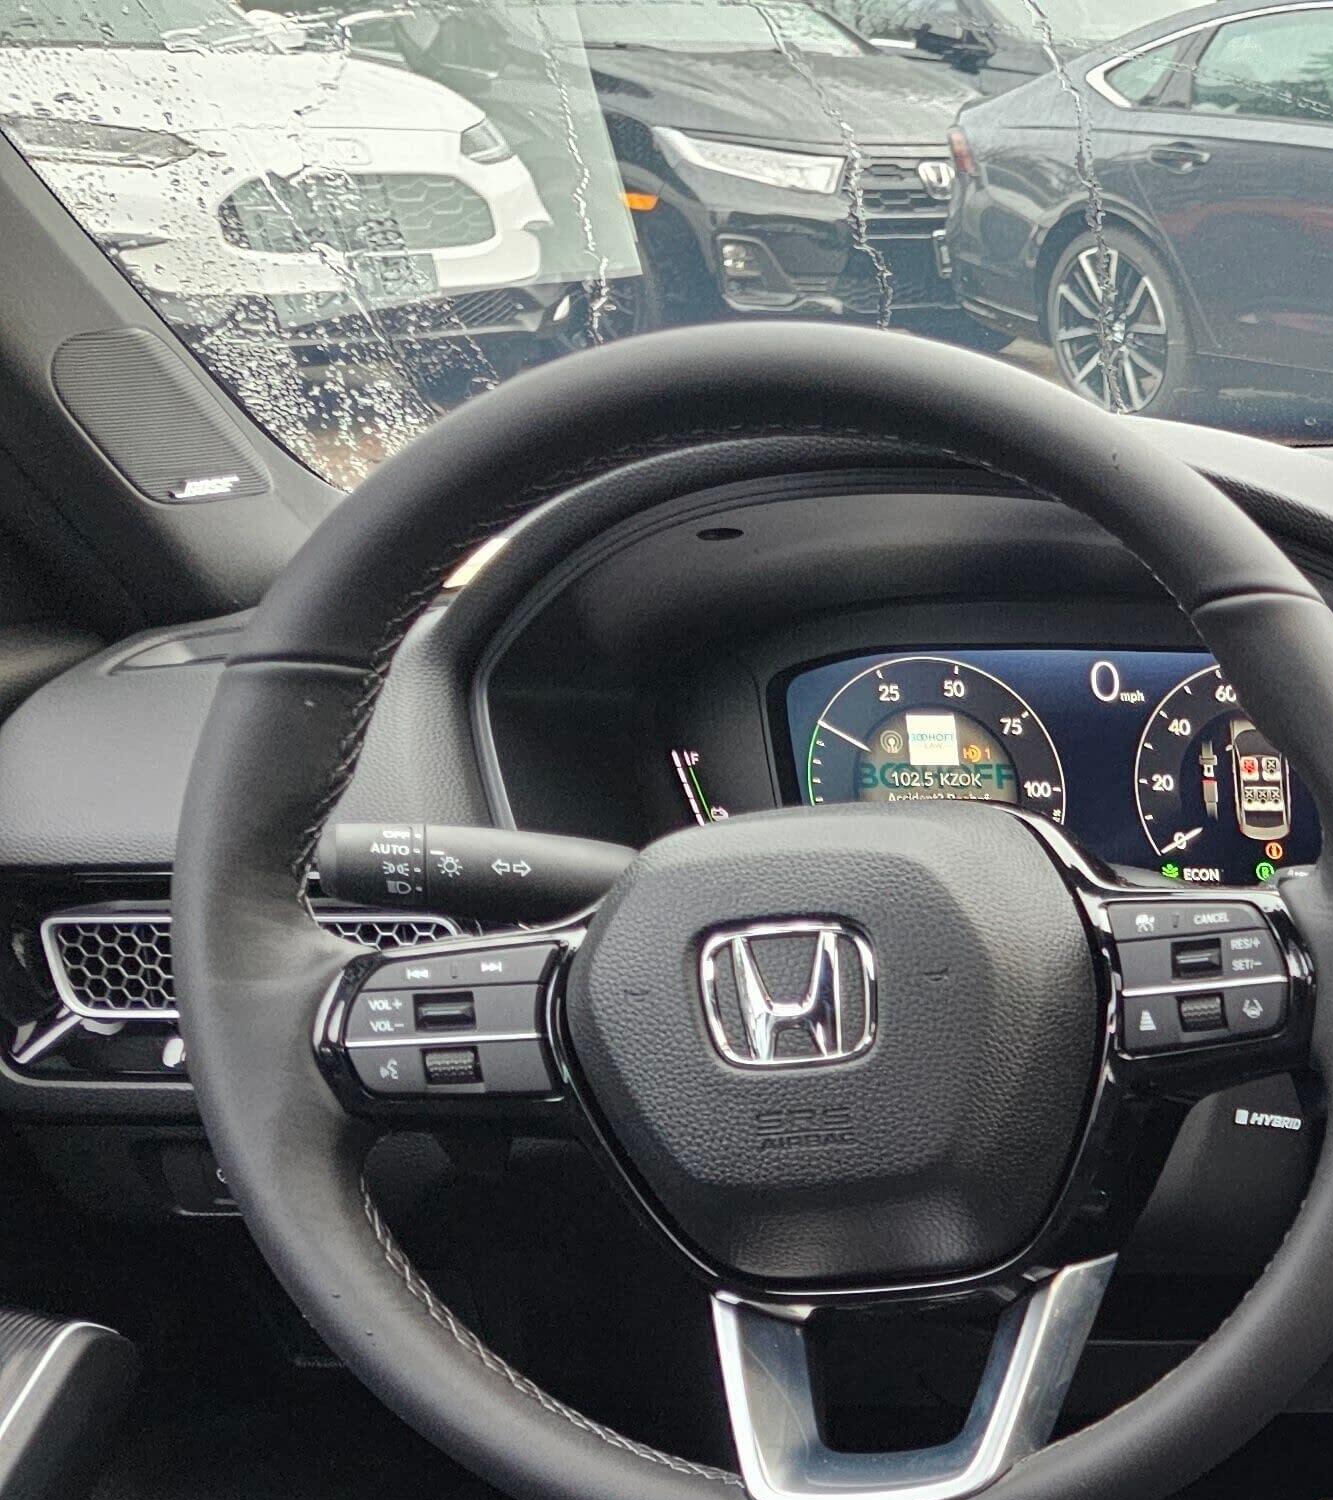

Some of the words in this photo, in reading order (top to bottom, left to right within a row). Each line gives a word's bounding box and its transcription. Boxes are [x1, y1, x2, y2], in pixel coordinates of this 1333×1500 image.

[943, 680, 965, 698] 50
[1091, 661, 1120, 702] 0
[1120, 690, 1145, 704] mph
[878, 684, 900, 701] 25
[1215, 685, 1237, 702] 60
[1000, 717, 1023, 735] 75
[1168, 719, 1191, 736] 40
[892, 771, 934, 787] 102.5
[940, 771, 982, 787] KZOK
[1152, 774, 1174, 791] 20
[1024, 781, 1051, 798] 100
[370, 841, 410, 856] AUTO
[1183, 868, 1220, 881] ECON
[1193, 912, 1230, 925] CANCEL
[1250, 1111, 1302, 1131] HYBRID
